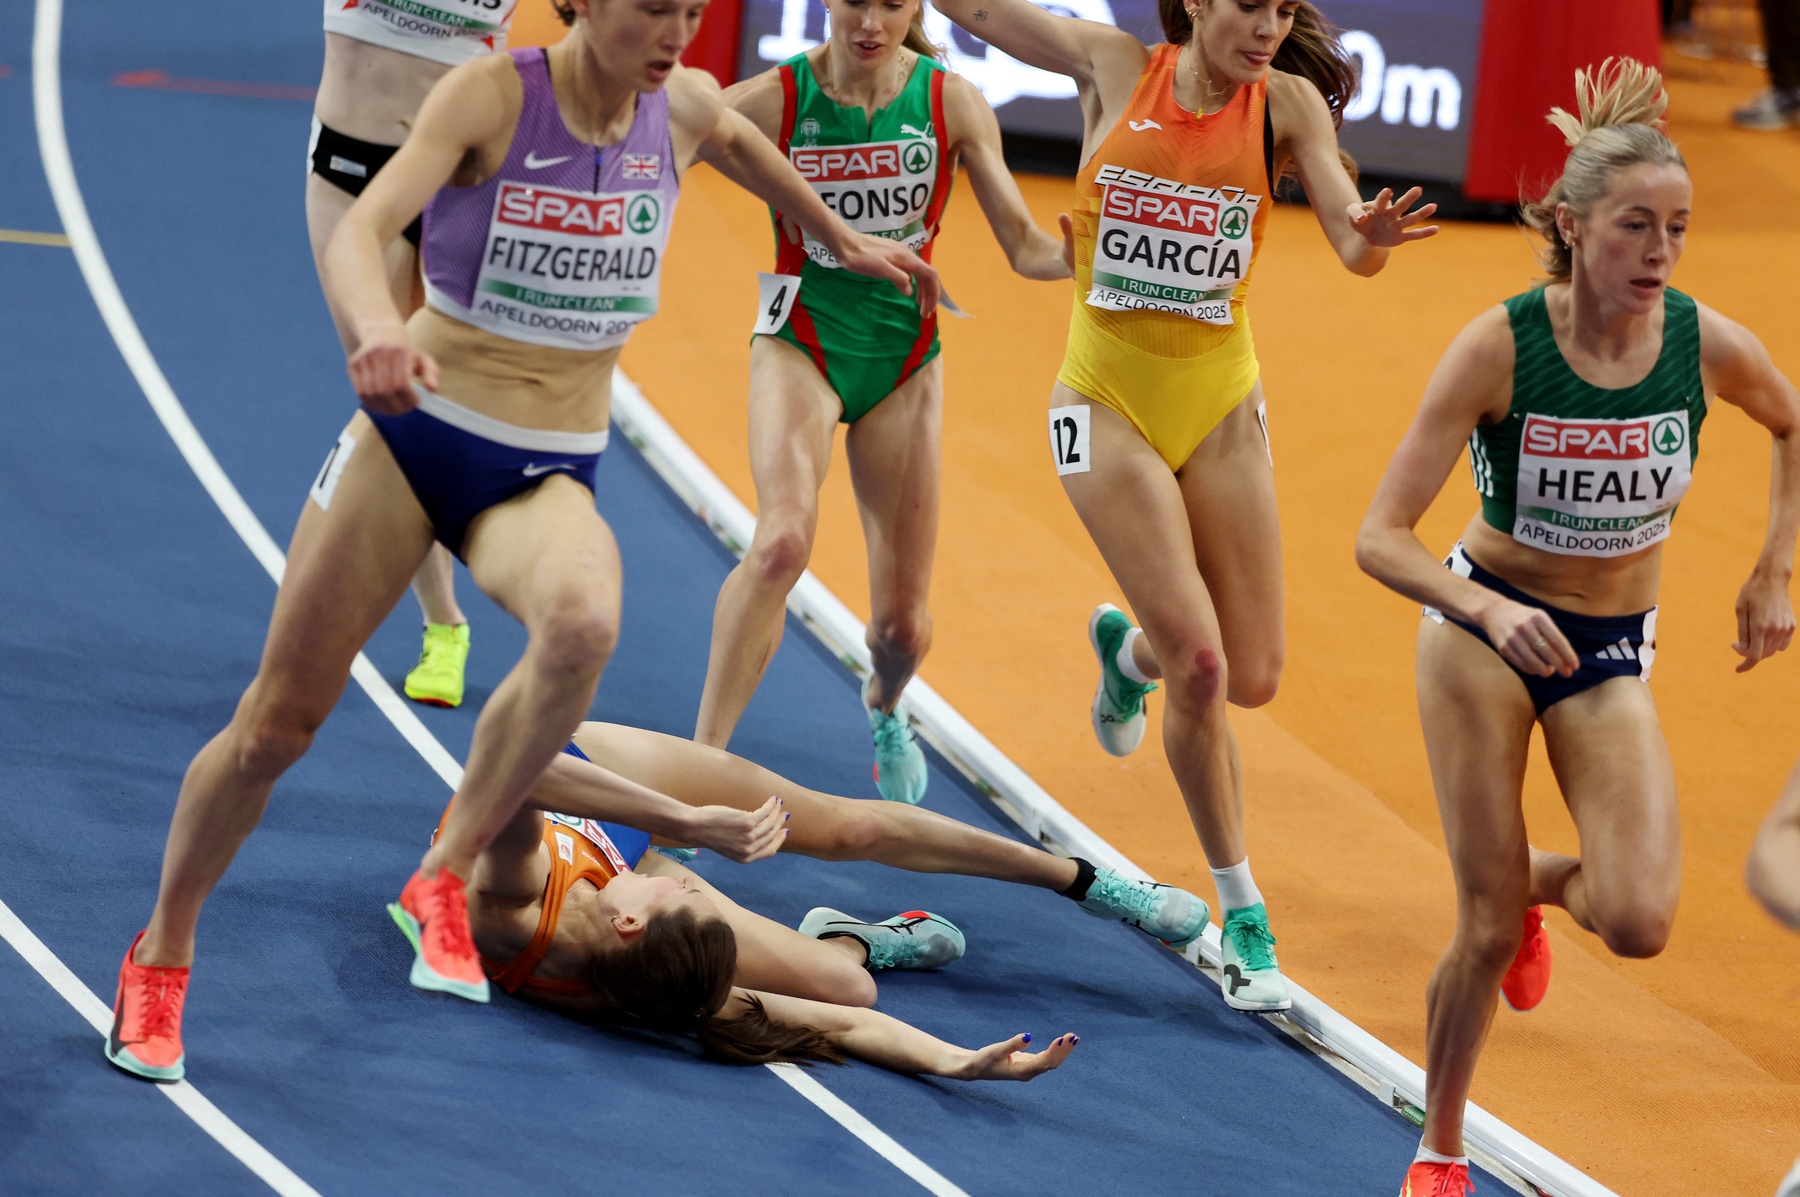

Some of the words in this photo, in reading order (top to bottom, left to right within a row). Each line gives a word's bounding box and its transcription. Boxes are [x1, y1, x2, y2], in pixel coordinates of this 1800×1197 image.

[363, 3, 451, 38] APELDOORN
[423, 8, 467, 27] CLEAN
[1338, 29, 1462, 131] 0m
[796, 149, 898, 178] SPAR
[501, 190, 623, 232] SPAR
[820, 182, 929, 221] FONSO
[1107, 190, 1217, 232] SPAR
[487, 236, 657, 282] FITZGERALD
[908, 238, 926, 253] 025
[1101, 228, 1241, 280] GARCÍA
[524, 290, 560, 306] RUN
[563, 297, 615, 311] CLEAN
[768, 285, 788, 326] 4
[1128, 279, 1160, 297] RUN
[1162, 287, 1207, 302] CLEAN
[480, 300, 600, 334] APELDOORN
[1197, 304, 1227, 320] 2025
[1053, 416, 1081, 465] 12
[1527, 424, 1647, 455] SPAR
[1537, 466, 1673, 503] HEALY
[1519, 523, 1634, 551] APELDOORN
[1637, 519, 1666, 546] 2025
[1559, 514, 1593, 530] RUN
[1597, 515, 1646, 531] CLEAN
